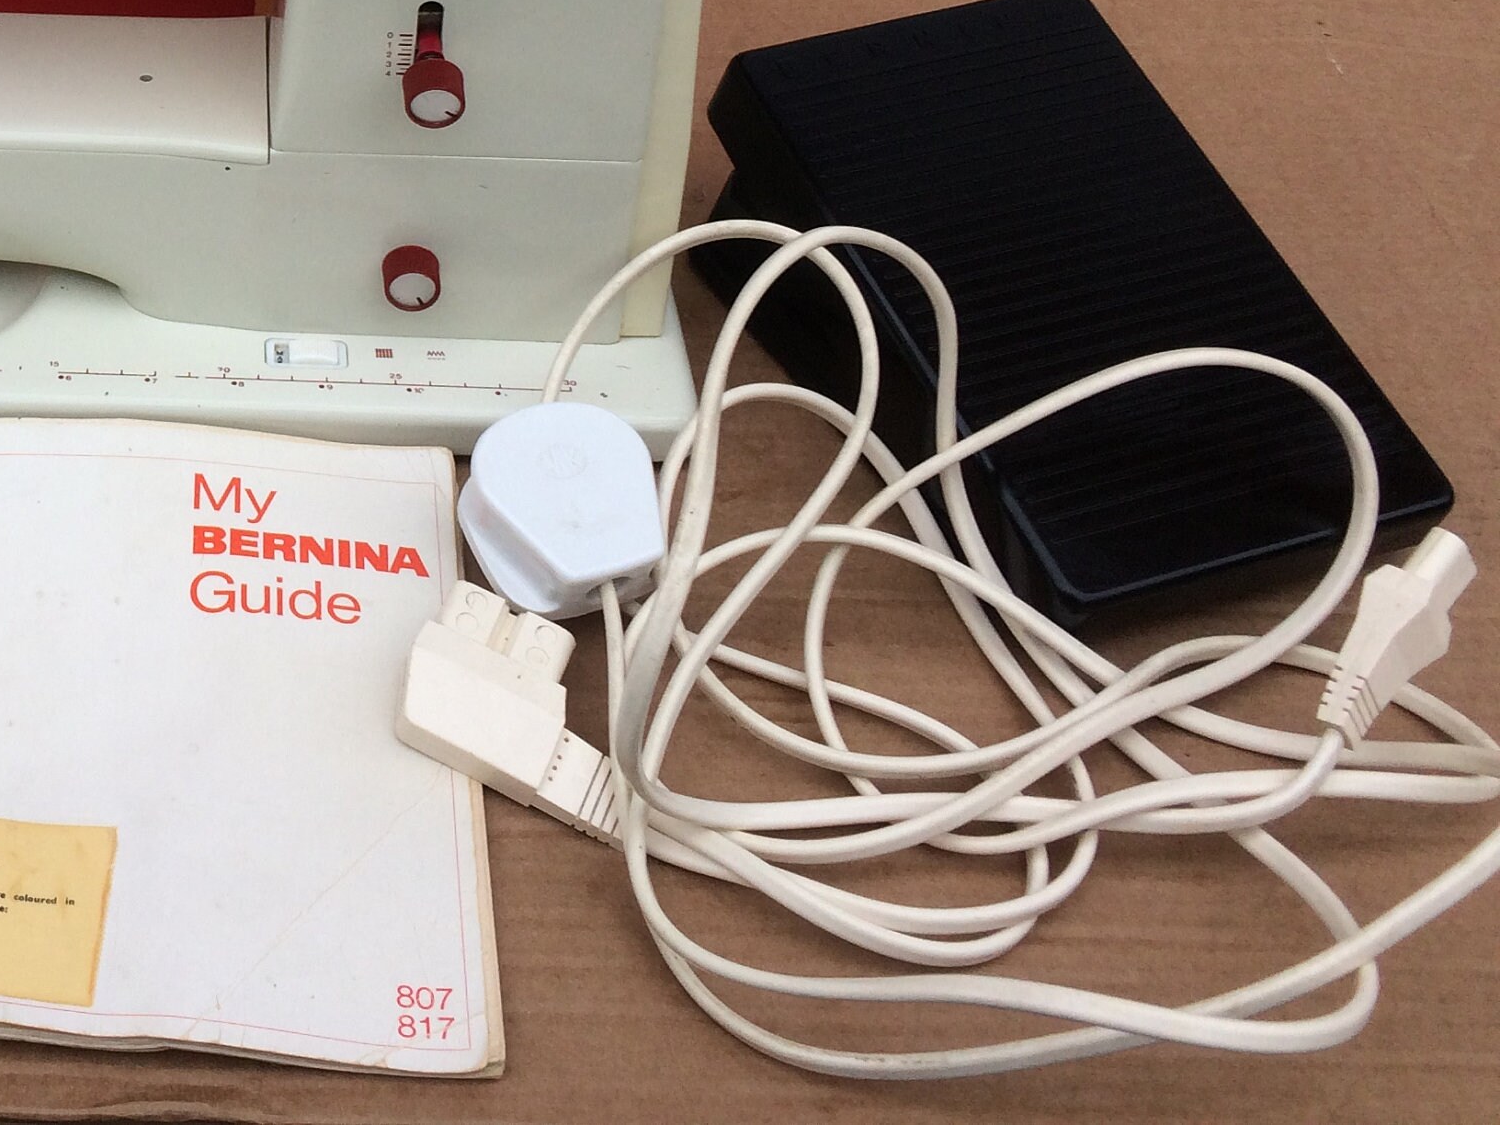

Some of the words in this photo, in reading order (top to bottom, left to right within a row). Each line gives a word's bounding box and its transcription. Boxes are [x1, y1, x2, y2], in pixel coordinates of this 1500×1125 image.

[193, 472, 277, 523] My
[192, 525, 430, 577] BERNINA
[189, 569, 362, 624] Guide
[14, 893, 57, 905] coloured
[65, 897, 75, 906] in
[397, 985, 453, 1010] 807
[398, 1014, 455, 1040] 817
